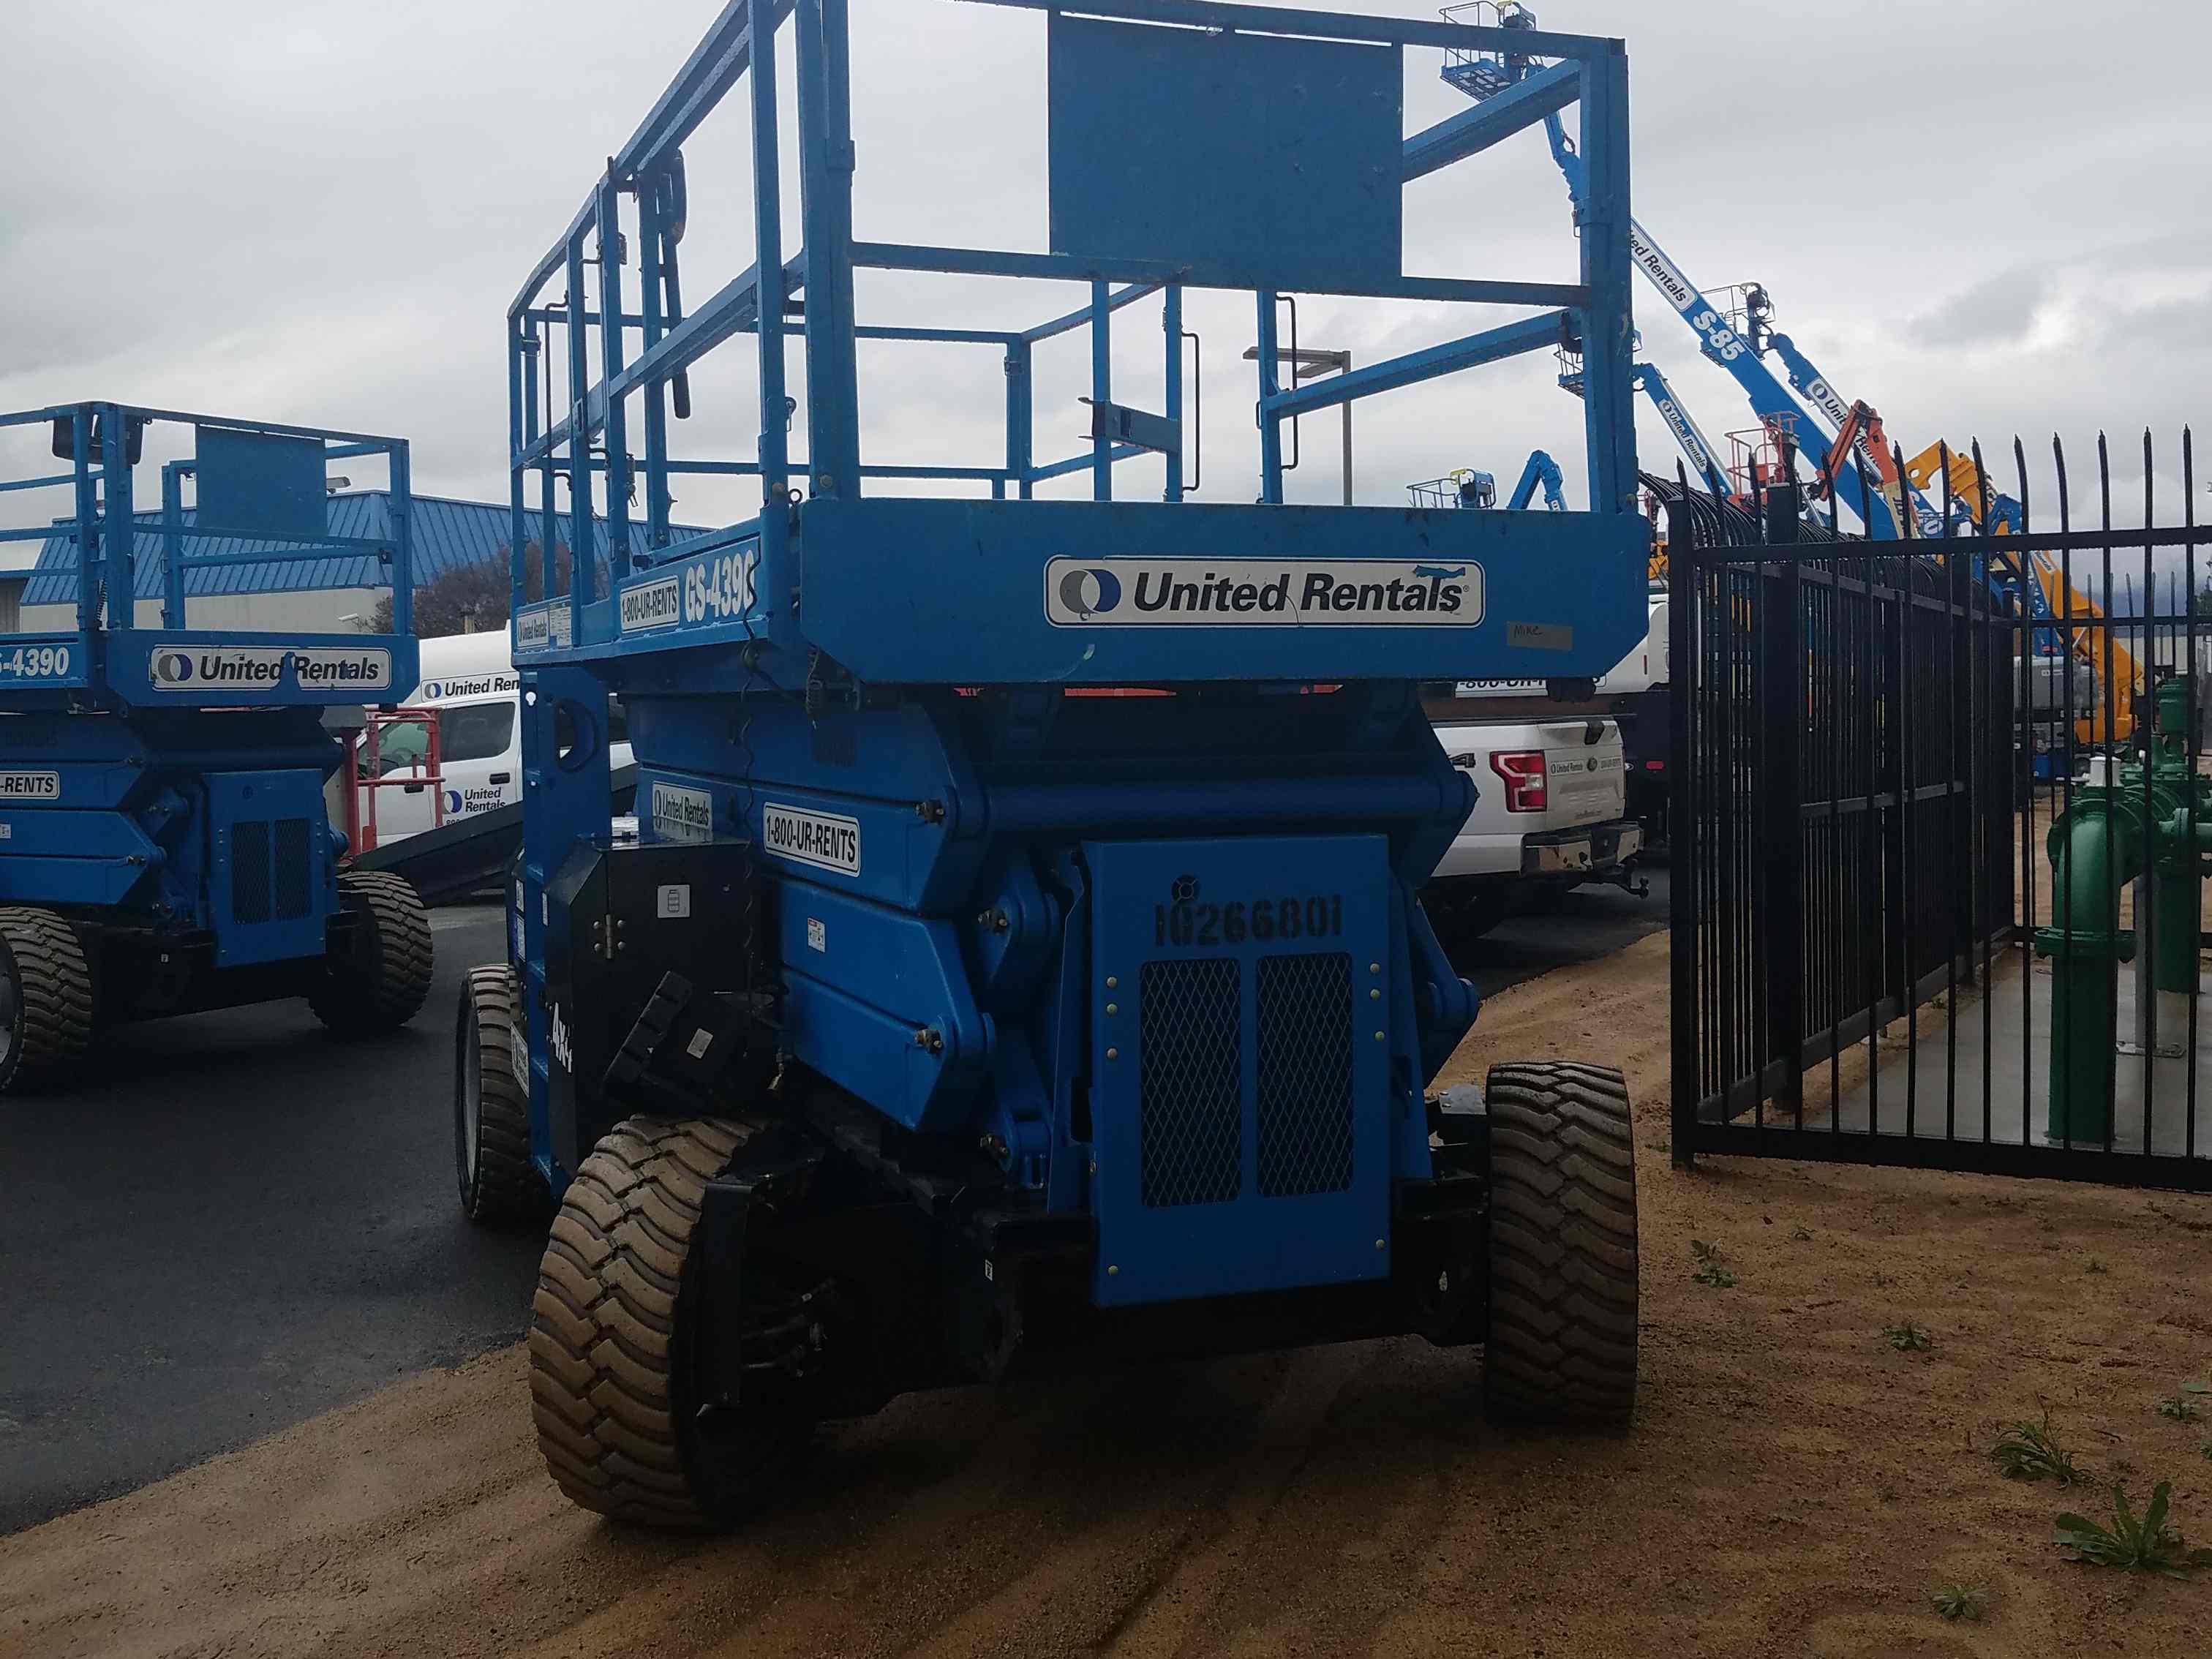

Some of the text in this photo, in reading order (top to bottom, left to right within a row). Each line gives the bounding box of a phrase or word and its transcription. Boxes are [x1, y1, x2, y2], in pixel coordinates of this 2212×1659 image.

[1644, 254, 1687, 302] Rentals
[1693, 311, 1746, 360] S-85
[1669, 413, 1707, 468] United Rentals
[622, 584, 677, 623] 1-800-UR-RENTS
[1135, 571, 1462, 612] United Rentals
[0, 647, 69, 677] -4390
[200, 655, 379, 680] United Rentals
[445, 680, 490, 696] United
[464, 788, 502, 800] United
[465, 800, 506, 813] Rentals
[663, 792, 710, 826] United Rentals
[766, 814, 857, 863] 1-800-UR-RENTS
[1154, 895, 1342, 947] 10266801
